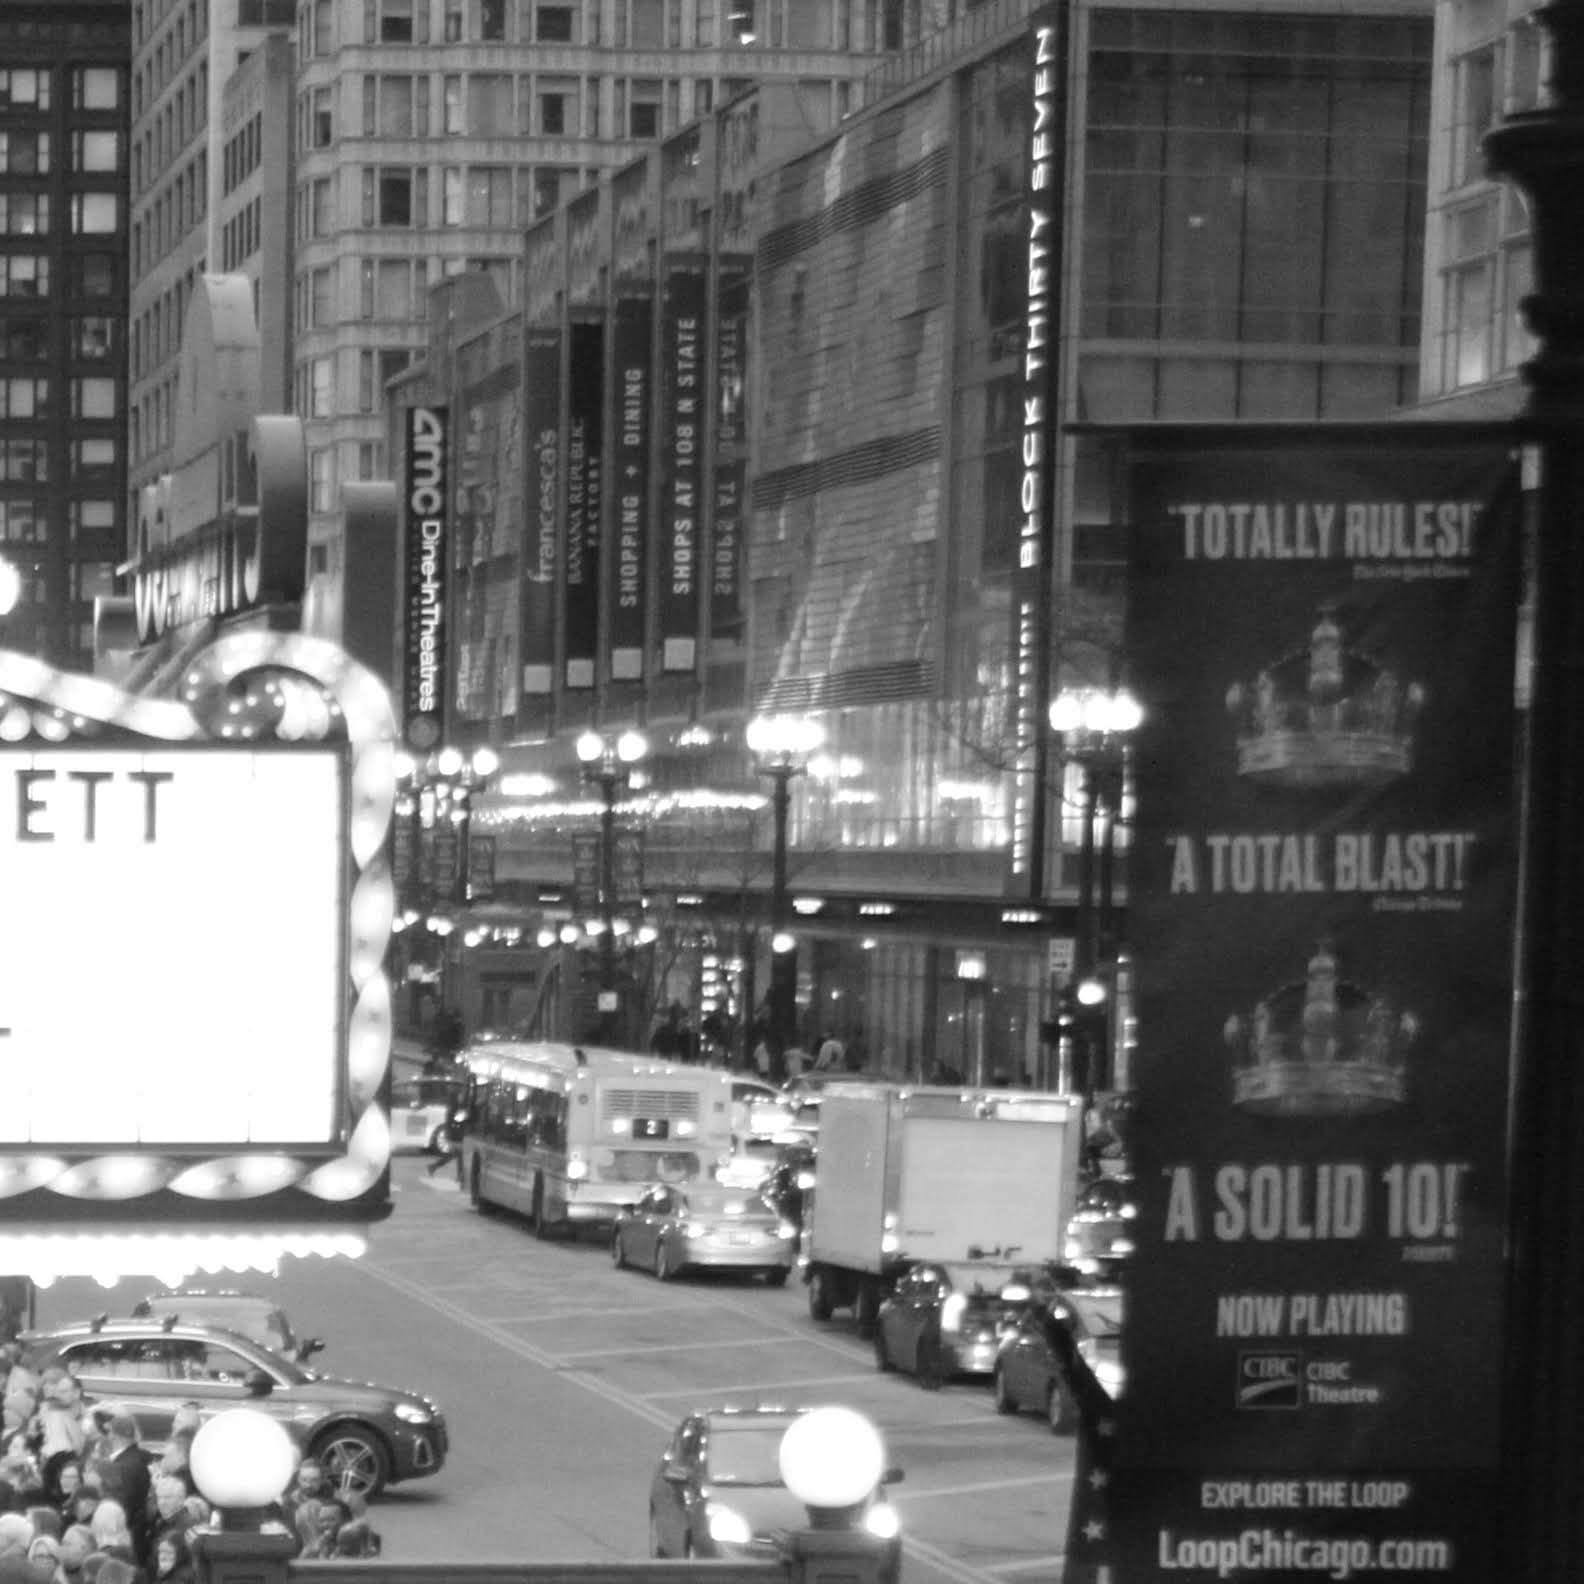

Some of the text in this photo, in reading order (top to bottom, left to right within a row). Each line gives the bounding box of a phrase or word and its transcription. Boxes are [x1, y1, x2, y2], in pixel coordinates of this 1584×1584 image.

[1020, 27, 1053, 568] BLOCK THIRTY SEVEN
[624, 368, 643, 446] DINING
[673, 318, 696, 595] SHOPS AT 108 N STATE
[528, 429, 557, 584] francesca's
[620, 495, 640, 607] SHOPPING
[1207, 835, 1324, 893] TOTAL
[1215, 1164, 1365, 1240] SOLID
[1217, 1294, 1406, 1336] NOW PLAYING
[1244, 1356, 1296, 1378] CIBC
[1306, 1362, 1351, 1381] CIBC
[1307, 1383, 1379, 1403] Theatre
[1201, 1482, 1408, 1508] EXPLORE THE LOOP
[1159, 1529, 1449, 1580] LoopChicago.com
